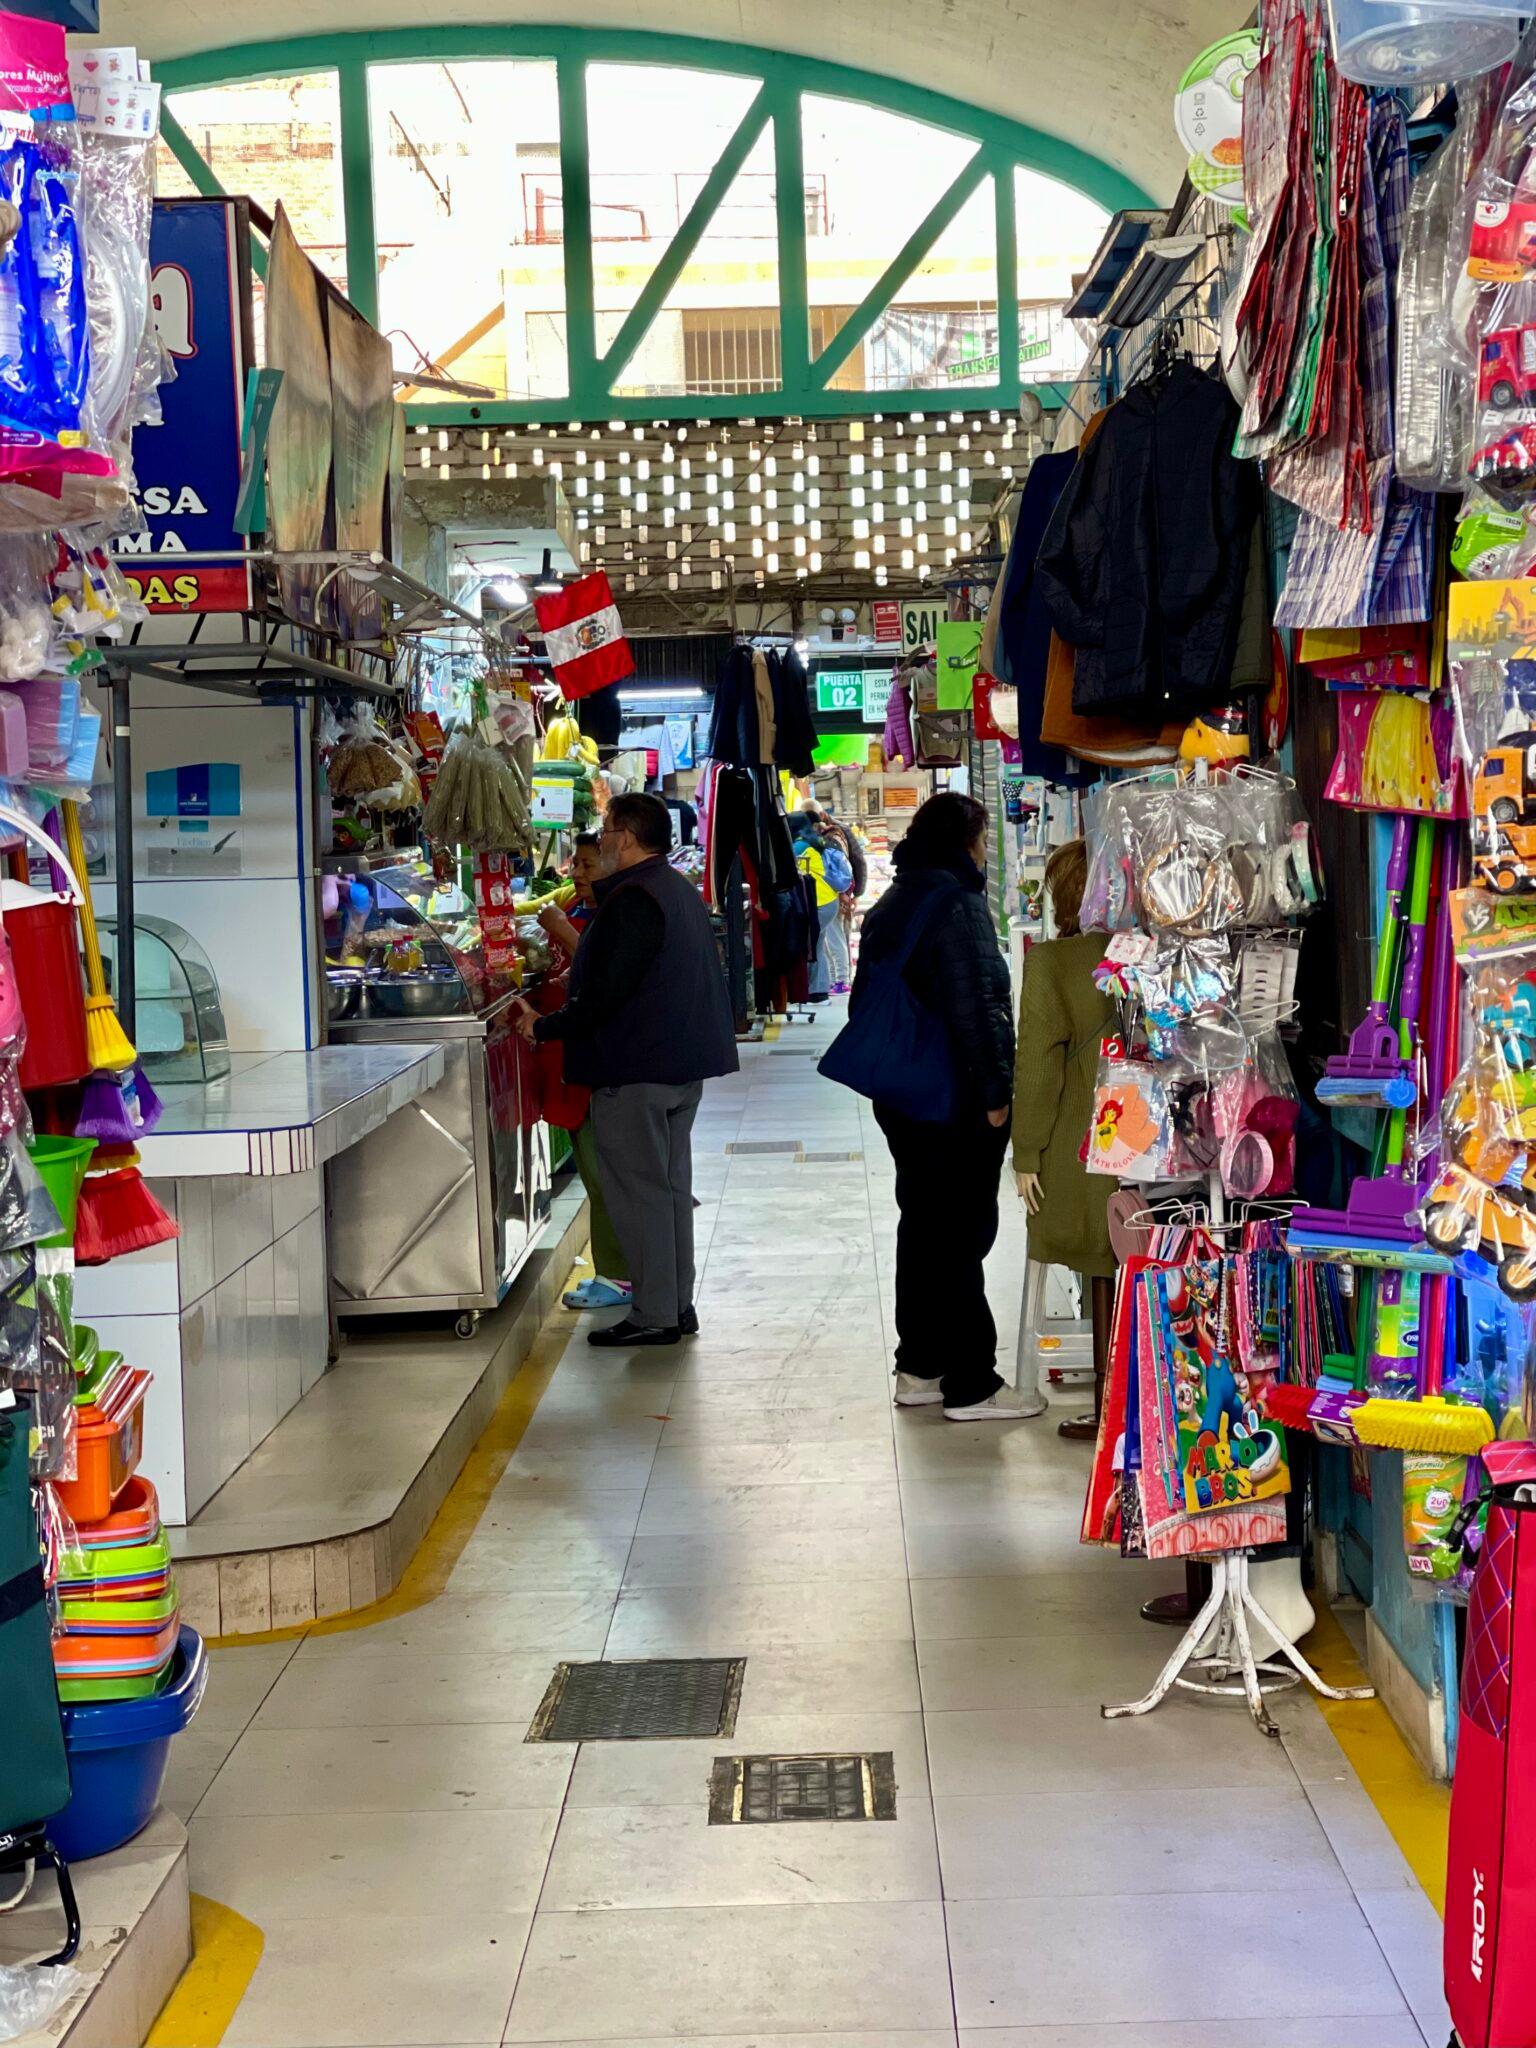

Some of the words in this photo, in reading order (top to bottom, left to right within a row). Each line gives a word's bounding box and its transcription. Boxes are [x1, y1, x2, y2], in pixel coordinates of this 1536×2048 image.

[946, 339, 1051, 381] TRANSFOATION
[823, 674, 862, 686] PUERTA
[875, 679, 887, 688] ESTA
[832, 687, 857, 707] 02
[1091, 1153, 1110, 1169] BATH
[1112, 1151, 1137, 1169] GLOVE
[1186, 1436, 1257, 1478] MARIO
